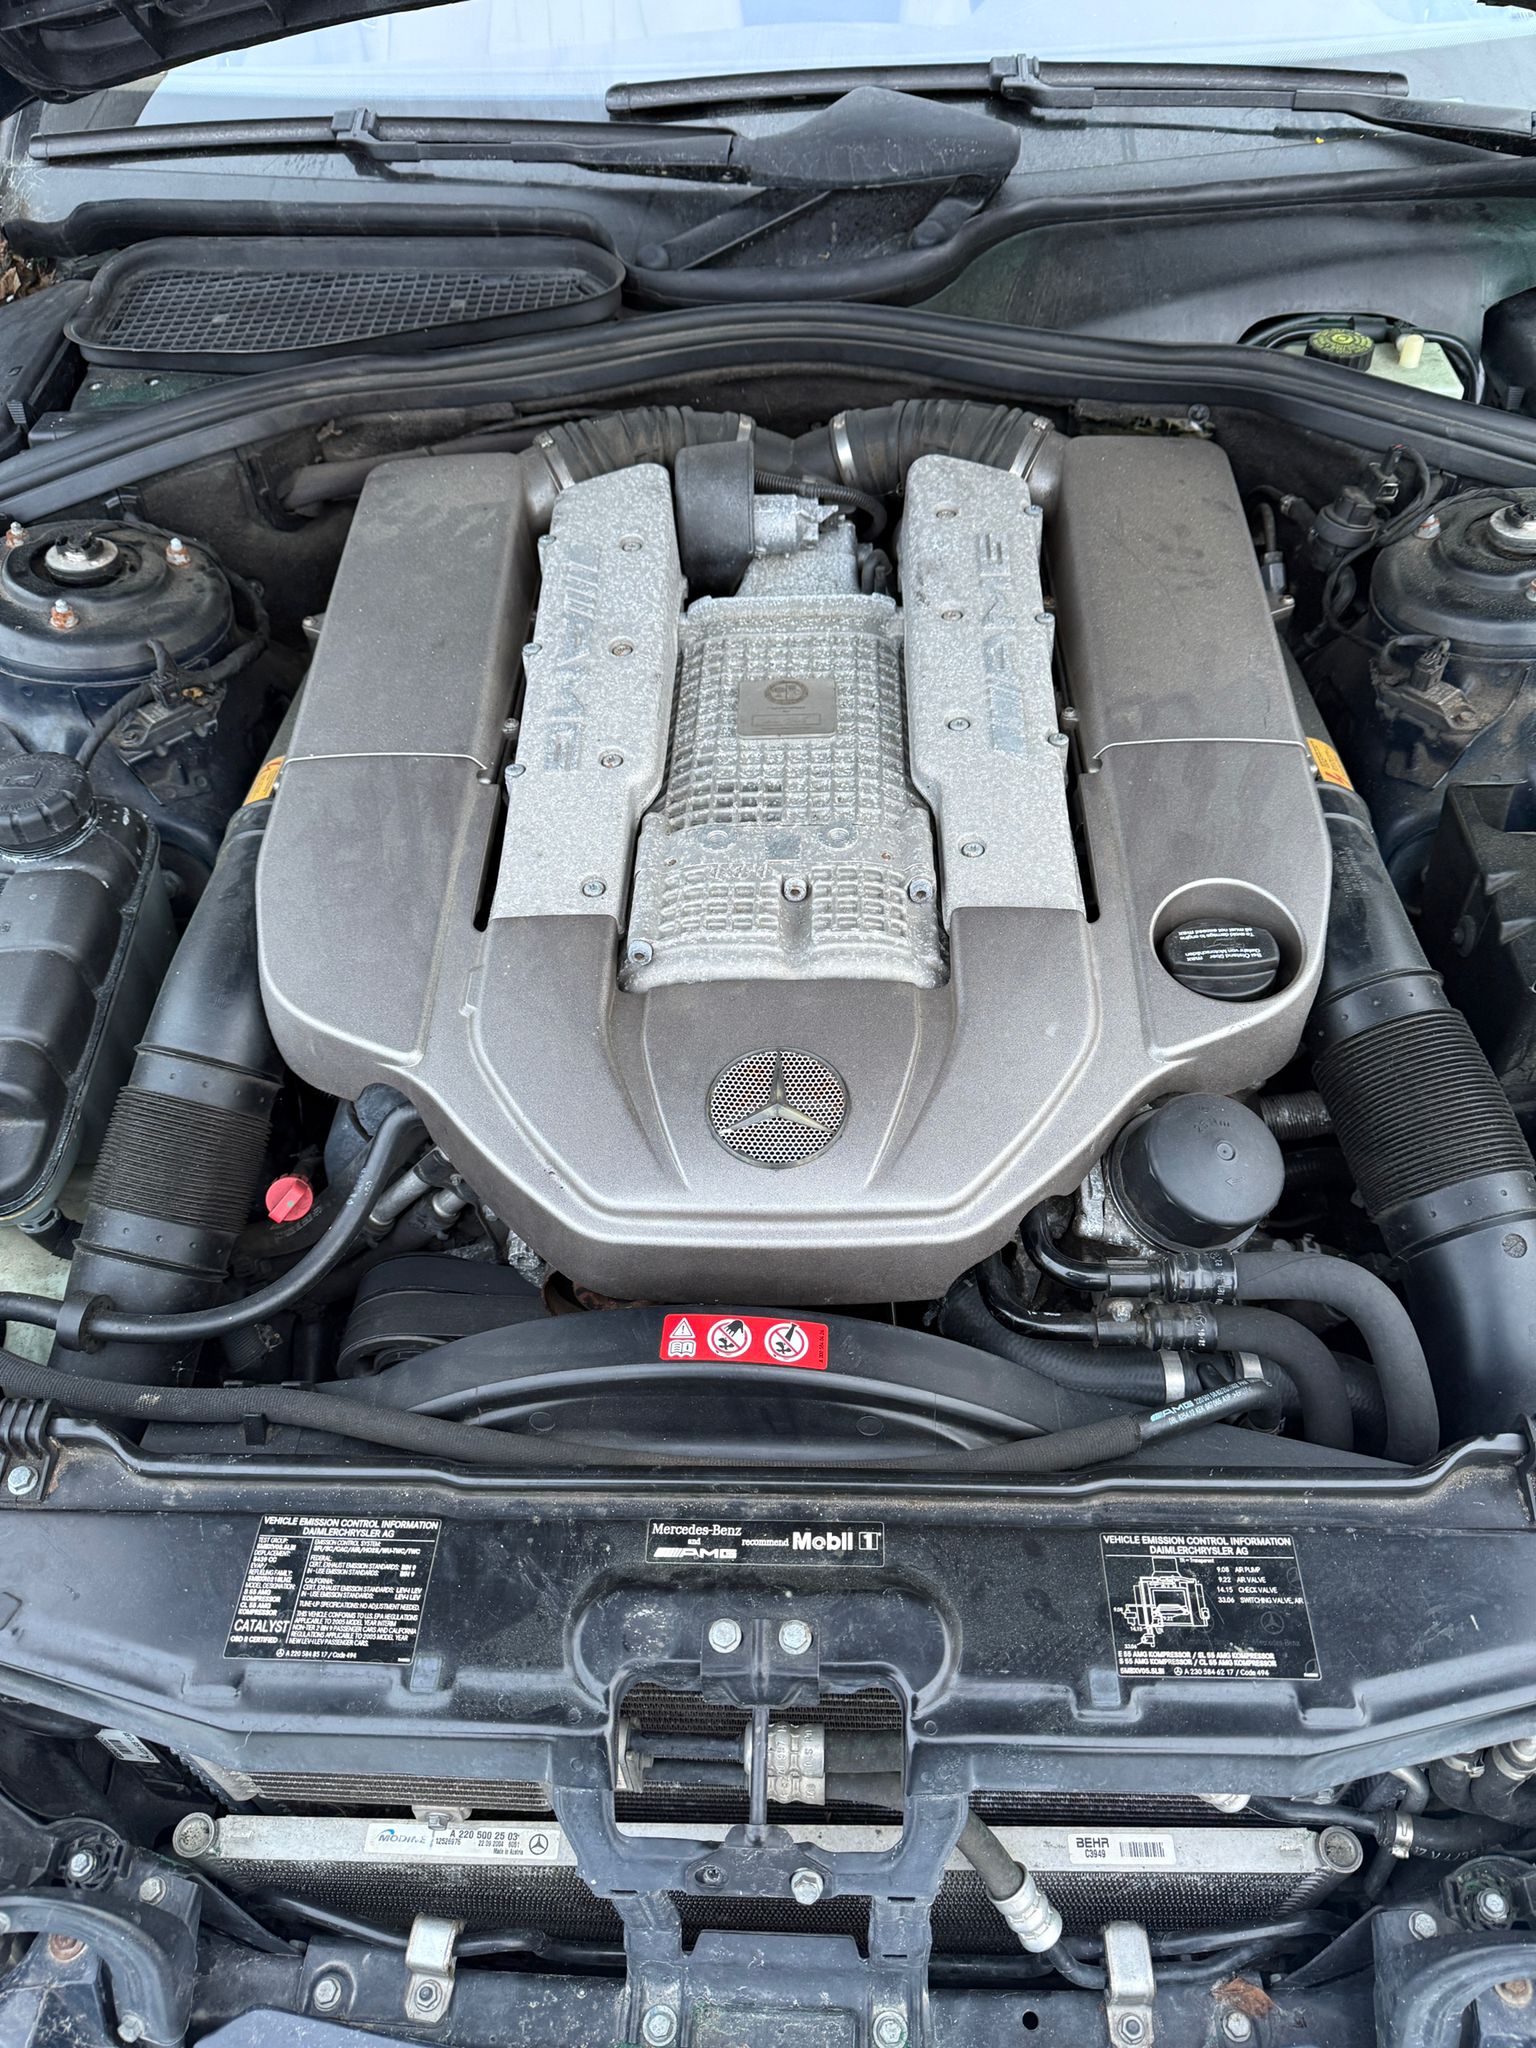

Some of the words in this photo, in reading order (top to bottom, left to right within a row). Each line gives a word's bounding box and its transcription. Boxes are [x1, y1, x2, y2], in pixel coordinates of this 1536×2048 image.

[264, 1516, 299, 1525] VEHICLE
[299, 1518, 339, 1527] EMISSION
[341, 1519, 379, 1528] CONTROL
[381, 1520, 439, 1529] INFORMATION
[302, 1527, 380, 1537] DAIMLERCHRYSLER
[382, 1530, 394, 1538] AG
[652, 1523, 742, 1536] Mercedes-Benz
[742, 1538, 789, 1547] recommend
[792, 1532, 853, 1550] Mobil
[1102, 1535, 1140, 1544] VEHICLE
[1141, 1536, 1185, 1544] EMISSION
[1186, 1536, 1229, 1545] CONTROL
[1230, 1537, 1291, 1546] INFORMATION
[680, 1548, 737, 1558] AMG
[1149, 1546, 1234, 1555] DAIMLERCHRYSLER
[1235, 1547, 1248, 1555] AG
[234, 1619, 290, 1633] CATALYST
[450, 1830, 456, 1838] A
[459, 1830, 473, 1839] 220
[477, 1831, 491, 1839] 500
[495, 1832, 505, 1840] 25
[1076, 1838, 1109, 1848] BEHR
[1085, 1849, 1106, 1858] C3949
